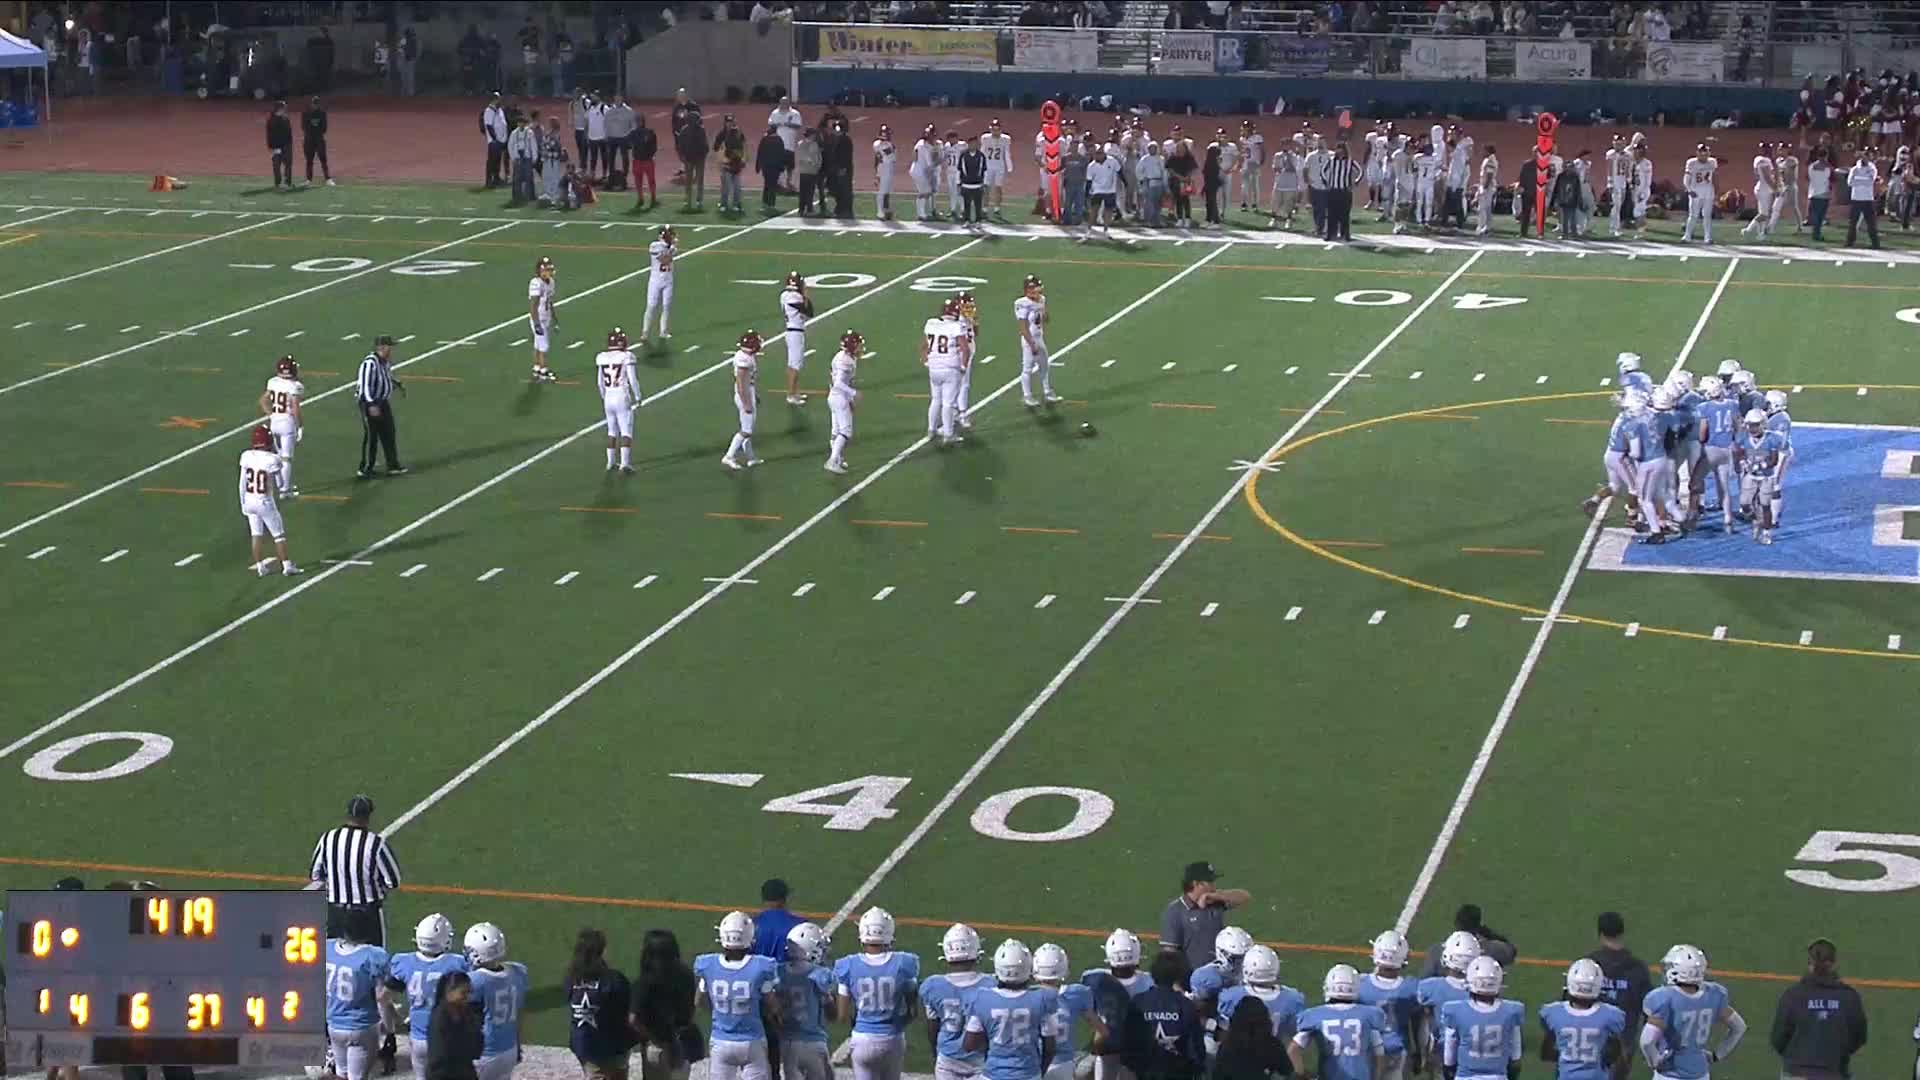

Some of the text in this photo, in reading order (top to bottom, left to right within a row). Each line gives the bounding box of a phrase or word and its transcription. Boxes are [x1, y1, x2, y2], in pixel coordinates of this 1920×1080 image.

[1161, 48, 1211, 61] PAINTER
[927, 334, 949, 354] 78
[602, 364, 623, 388] 57
[1714, 409, 1732, 433] 14
[245, 467, 268, 495] 20
[712, 980, 751, 1015] 82
[857, 976, 896, 1011] 80
[1808, 999, 1840, 1009] ALL IN
[990, 1008, 1032, 1046] 72
[1322, 1018, 1363, 1057] 53
[1468, 1024, 1502, 1059] 12
[1680, 1009, 1714, 1048] 78
[1559, 1027, 1600, 1063] 35
